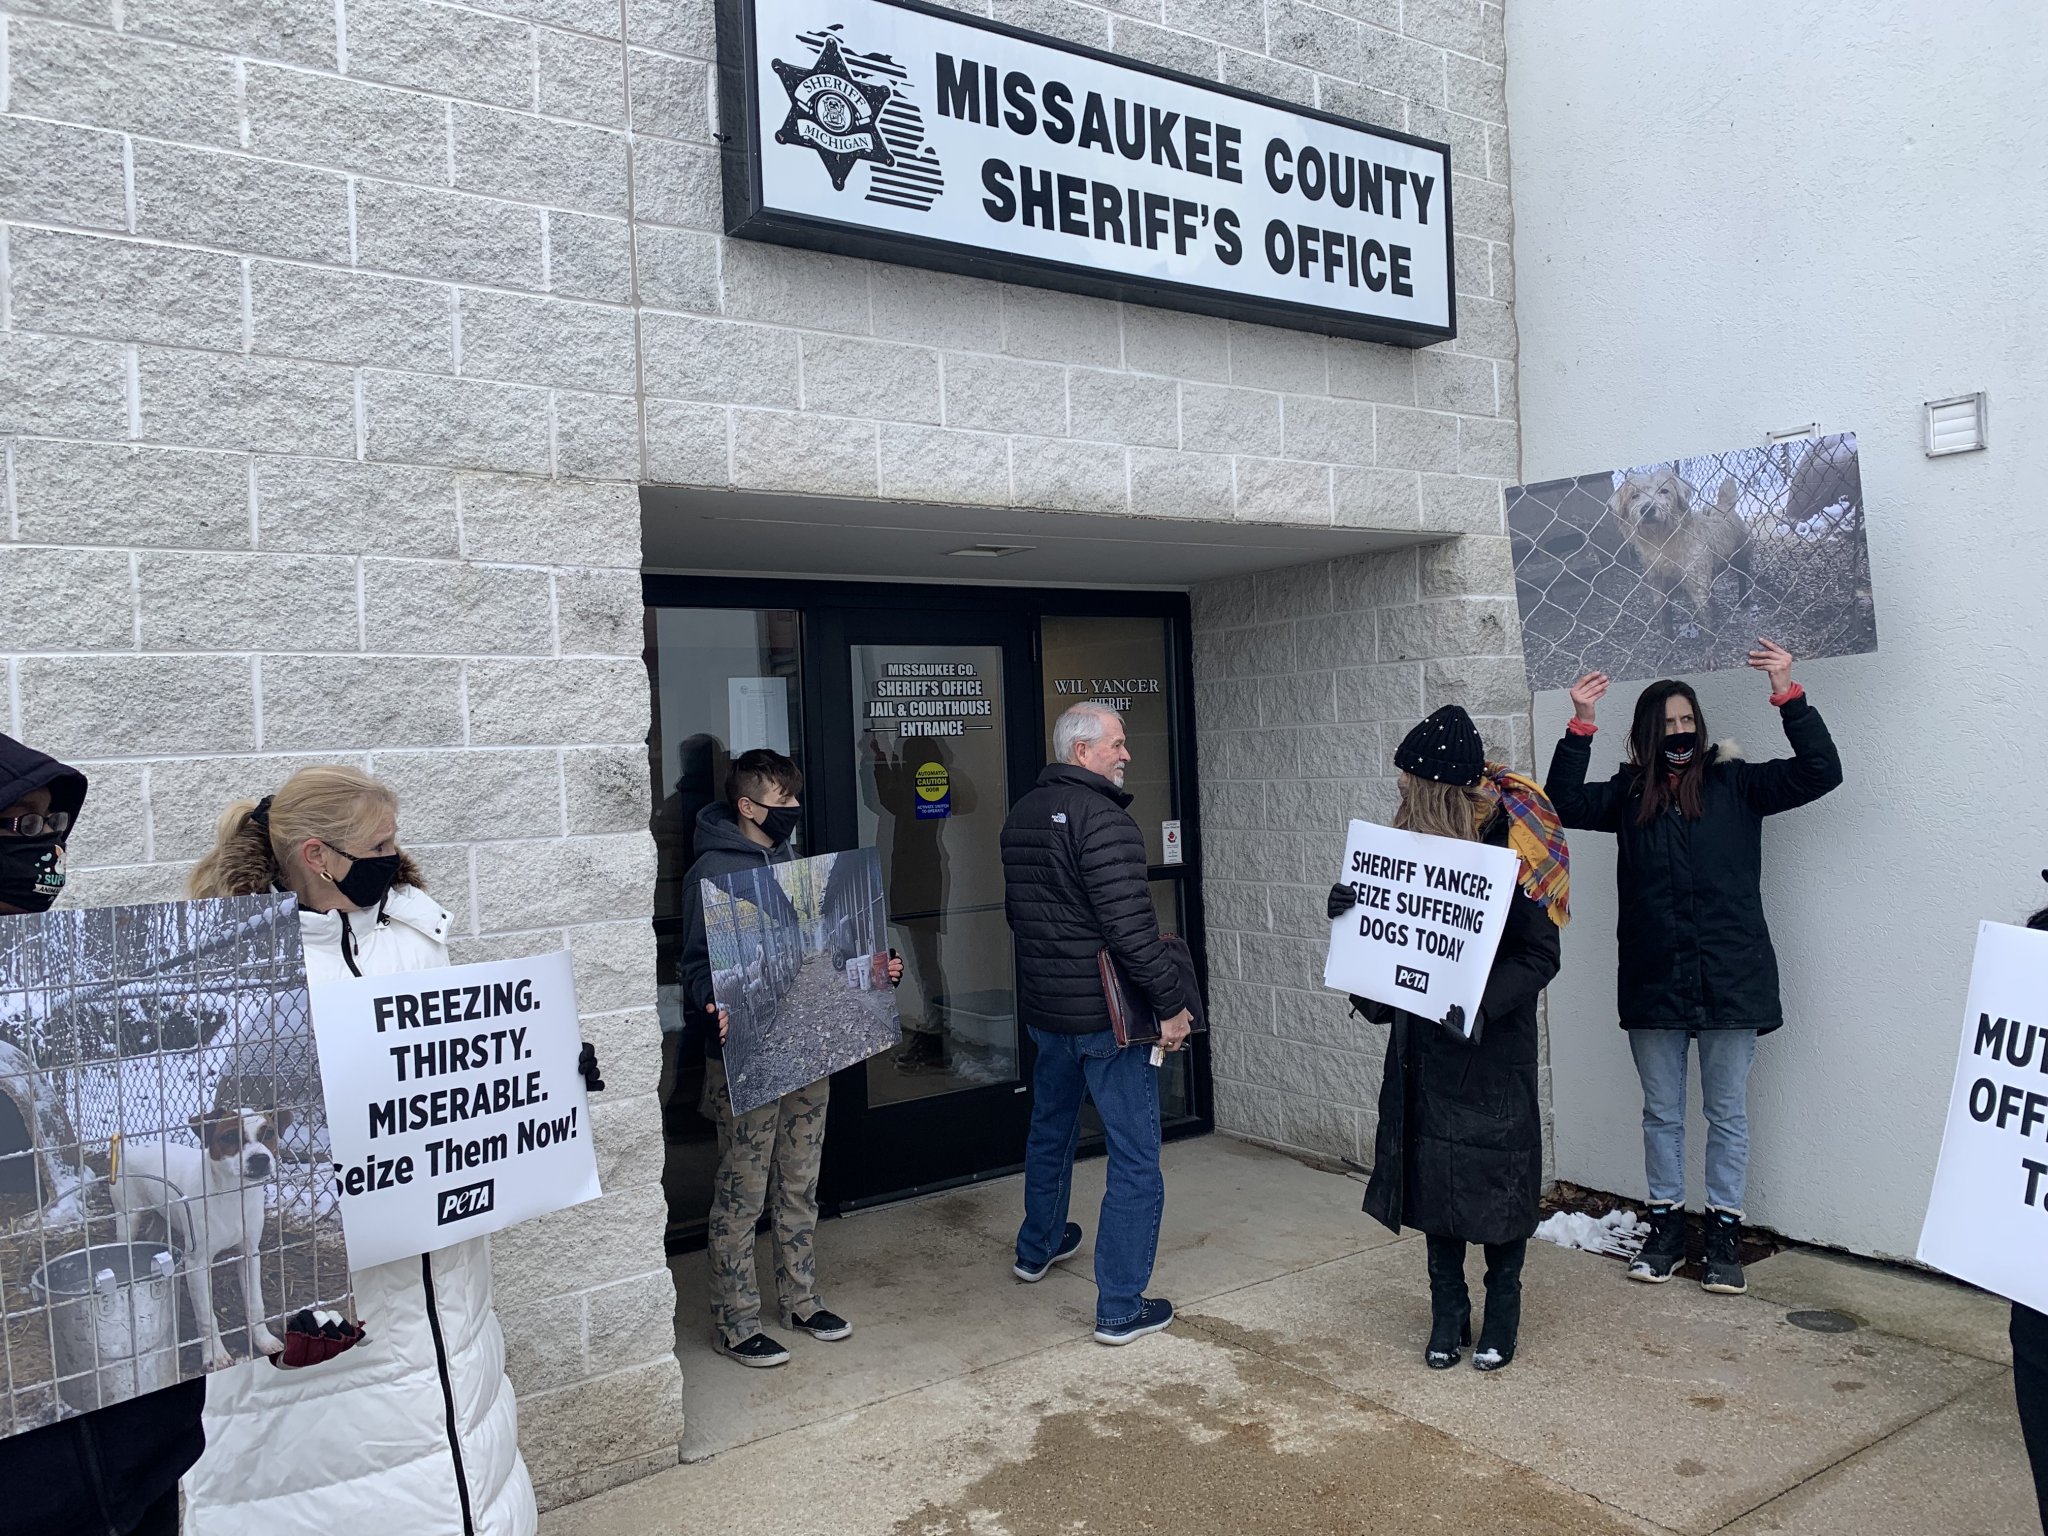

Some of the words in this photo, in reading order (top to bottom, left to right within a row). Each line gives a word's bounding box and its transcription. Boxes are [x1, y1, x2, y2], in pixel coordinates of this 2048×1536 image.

[803, 76, 866, 106] SHERIFF
[804, 125, 869, 149] MICHIGAN
[936, 52, 1242, 184] MISSAUKEE
[1265, 137, 1435, 225] COUNTY
[981, 158, 1243, 266] SHERIFF'S
[1265, 219, 1413, 297] OFFICE
[877, 681, 939, 696] SHERIFF'S
[941, 680, 982, 696] OFFICE
[887, 664, 956, 676] MISSAUKEE
[957, 664, 977, 676] CO.
[1055, 680, 1088, 694] WIL
[1090, 679, 1160, 693] YANCER
[869, 702, 895, 717] JAIL
[897, 703, 907, 717] &
[909, 700, 991, 716] COURTHOUSE
[900, 721, 964, 737] ENTRANCE
[917, 777, 947, 785] CAUTION
[1351, 850, 1417, 883] SHERIFF
[1424, 864, 1493, 901] YANCER:
[1396, 892, 1484, 934] SUFFERING
[1359, 915, 1409, 947] DOGS
[1415, 928, 1465, 962] TODAY
[373, 979, 541, 1033] FREEZING.
[390, 1027, 532, 1082] THIRSTY.
[369, 1071, 549, 1139] MISERABLE.
[1969, 1077, 2048, 1143] OFF
[425, 1132, 508, 1178] Them
[517, 1107, 578, 1153] Now!
